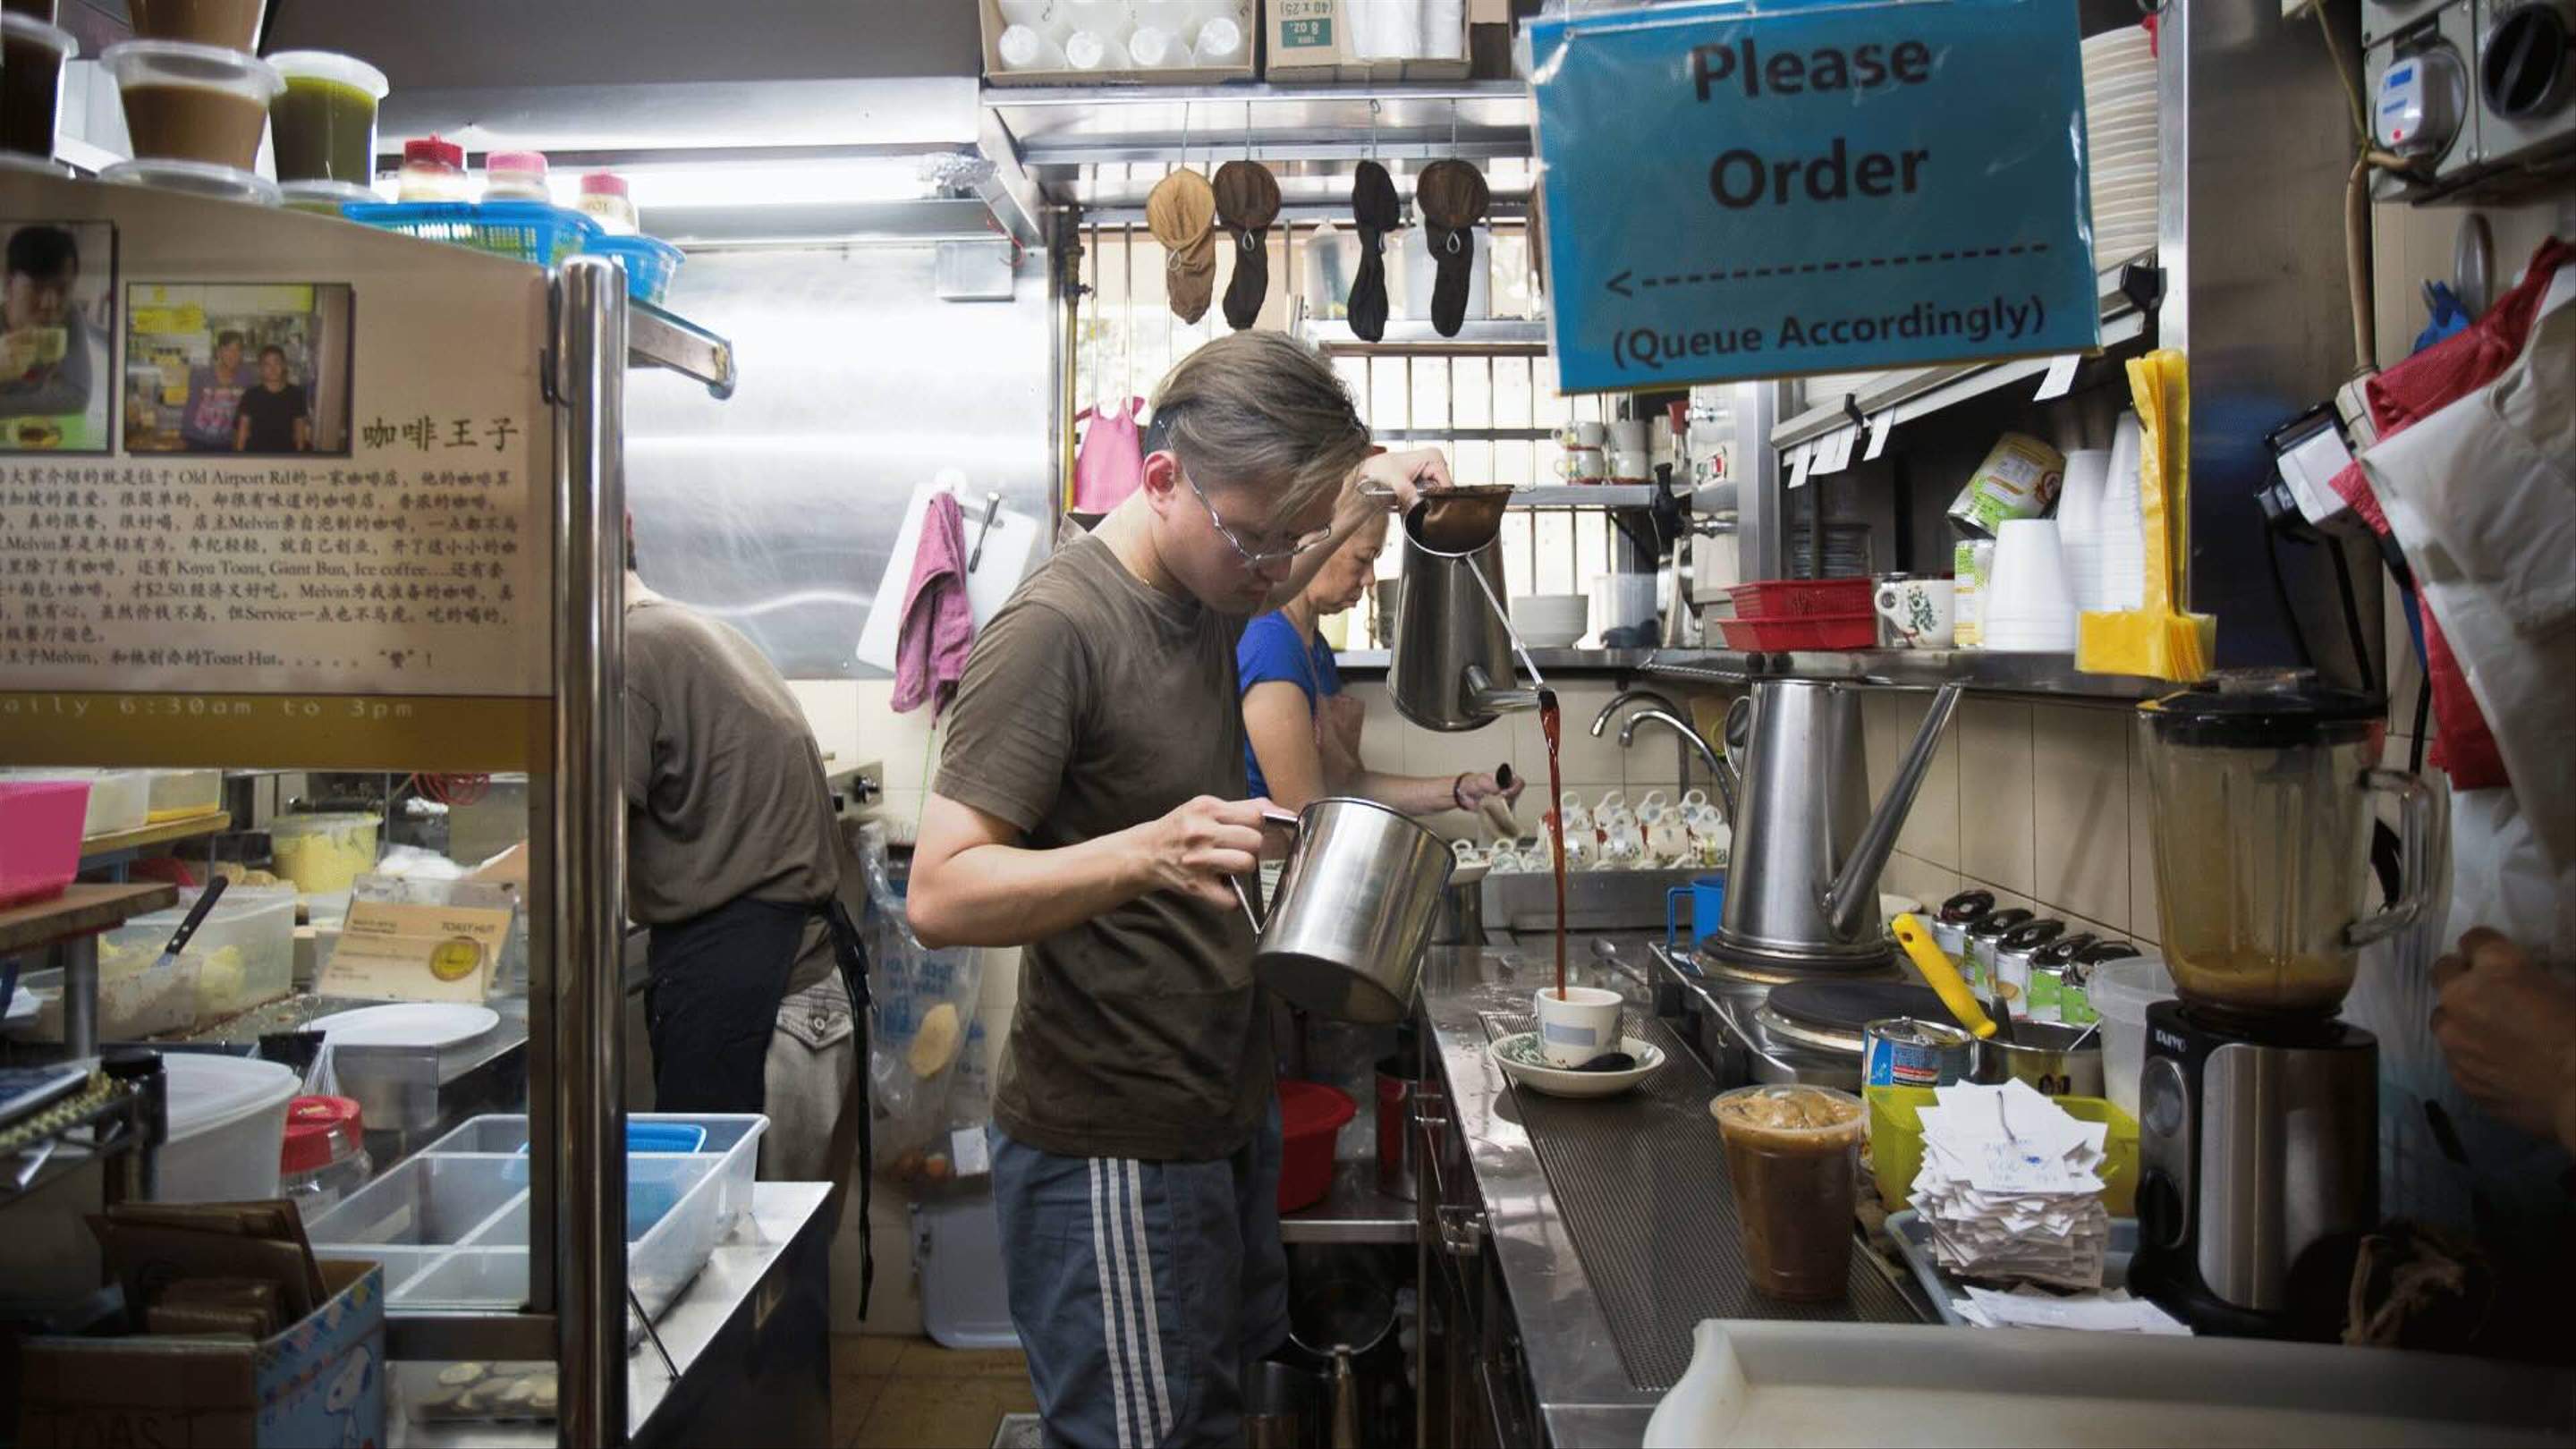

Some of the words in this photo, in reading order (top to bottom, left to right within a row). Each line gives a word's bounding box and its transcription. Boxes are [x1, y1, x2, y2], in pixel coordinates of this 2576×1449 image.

[1690, 38, 1931, 103] Please
[1709, 138, 1930, 209] Order
[1614, 328, 1762, 369] (Queue
[1777, 295, 2045, 350] Accordingly)
[361, 415, 519, 452] 咖啡王子
[179, 469, 207, 485] Old
[212, 469, 264, 487] Airport
[177, 560, 215, 577] Kaya
[270, 561, 310, 575] Giant
[317, 561, 350, 578] Bun,
[355, 561, 377, 575] Ice
[3, 695, 88, 717] aily
[119, 696, 253, 715] 6:30am
[284, 698, 321, 716] to
[350, 699, 413, 719] 3pm
